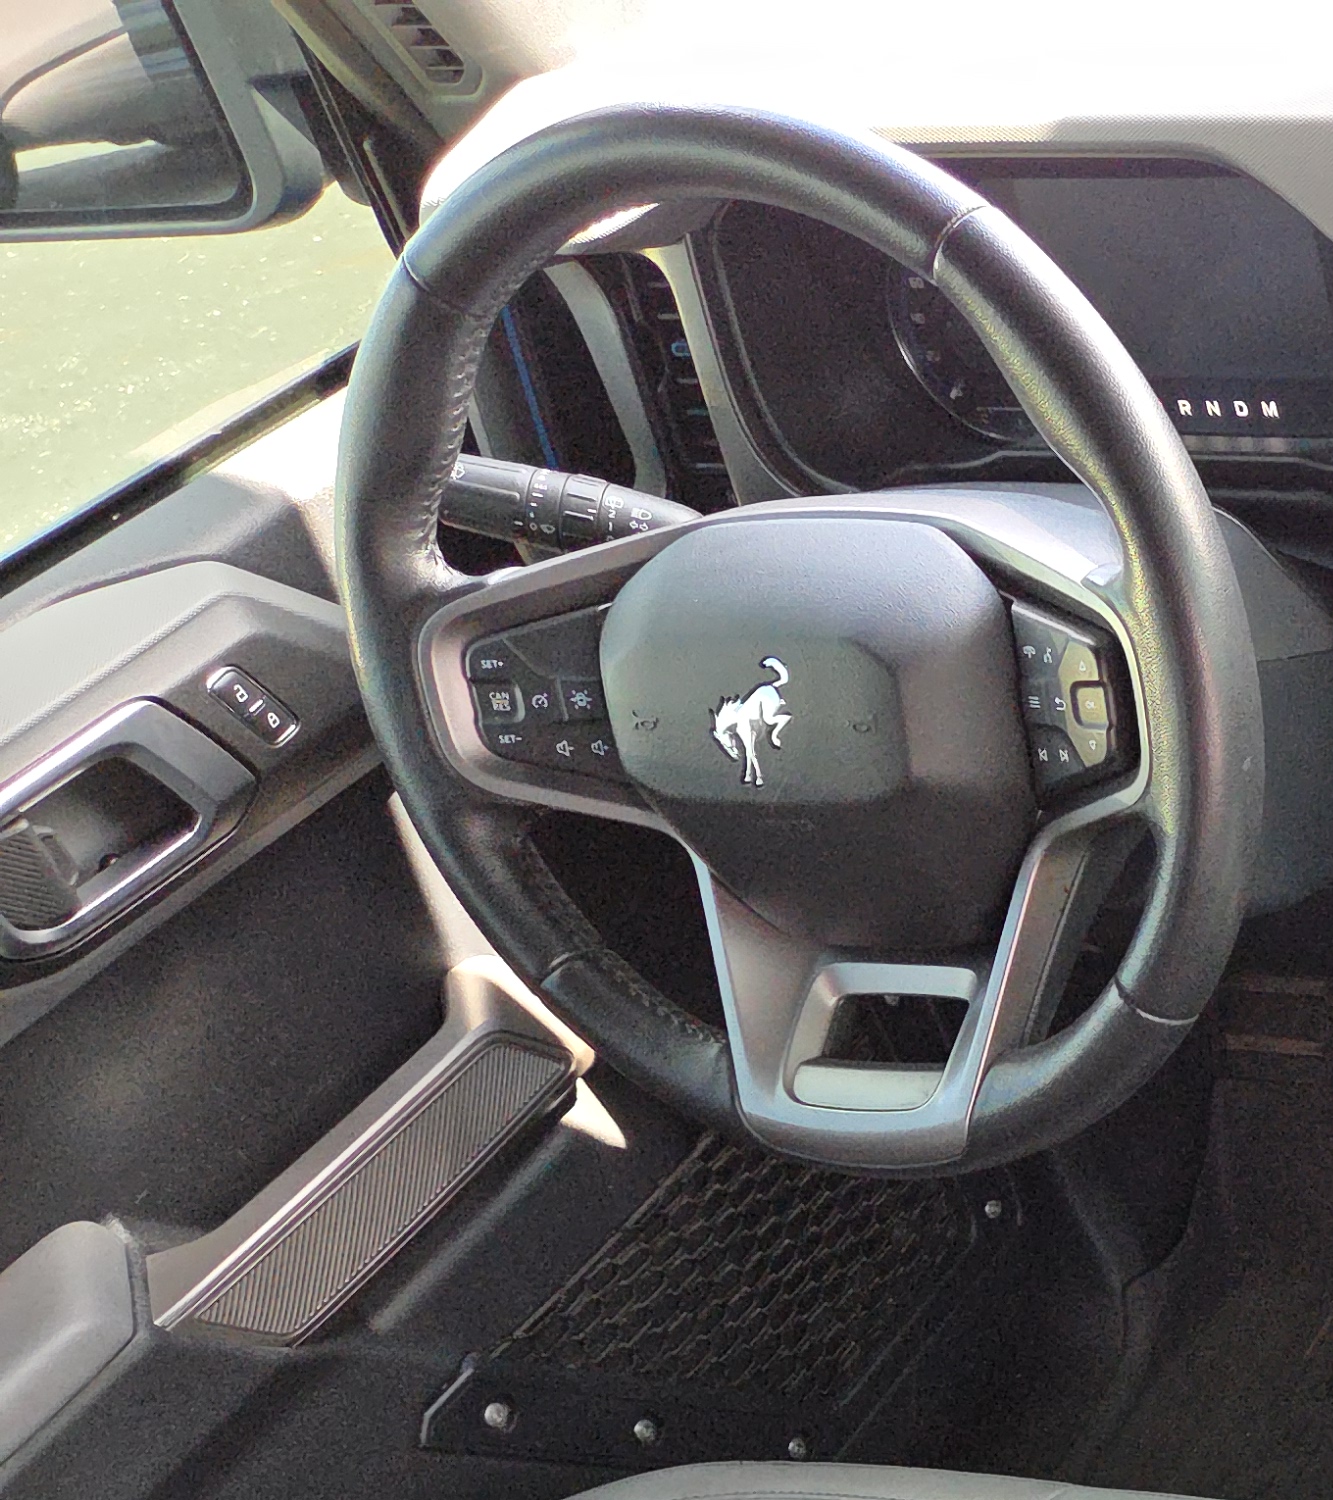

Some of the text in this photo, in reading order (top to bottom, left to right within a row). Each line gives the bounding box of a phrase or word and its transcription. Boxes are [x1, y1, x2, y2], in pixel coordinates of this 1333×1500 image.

[1177, 399, 1280, 419] R N D M
